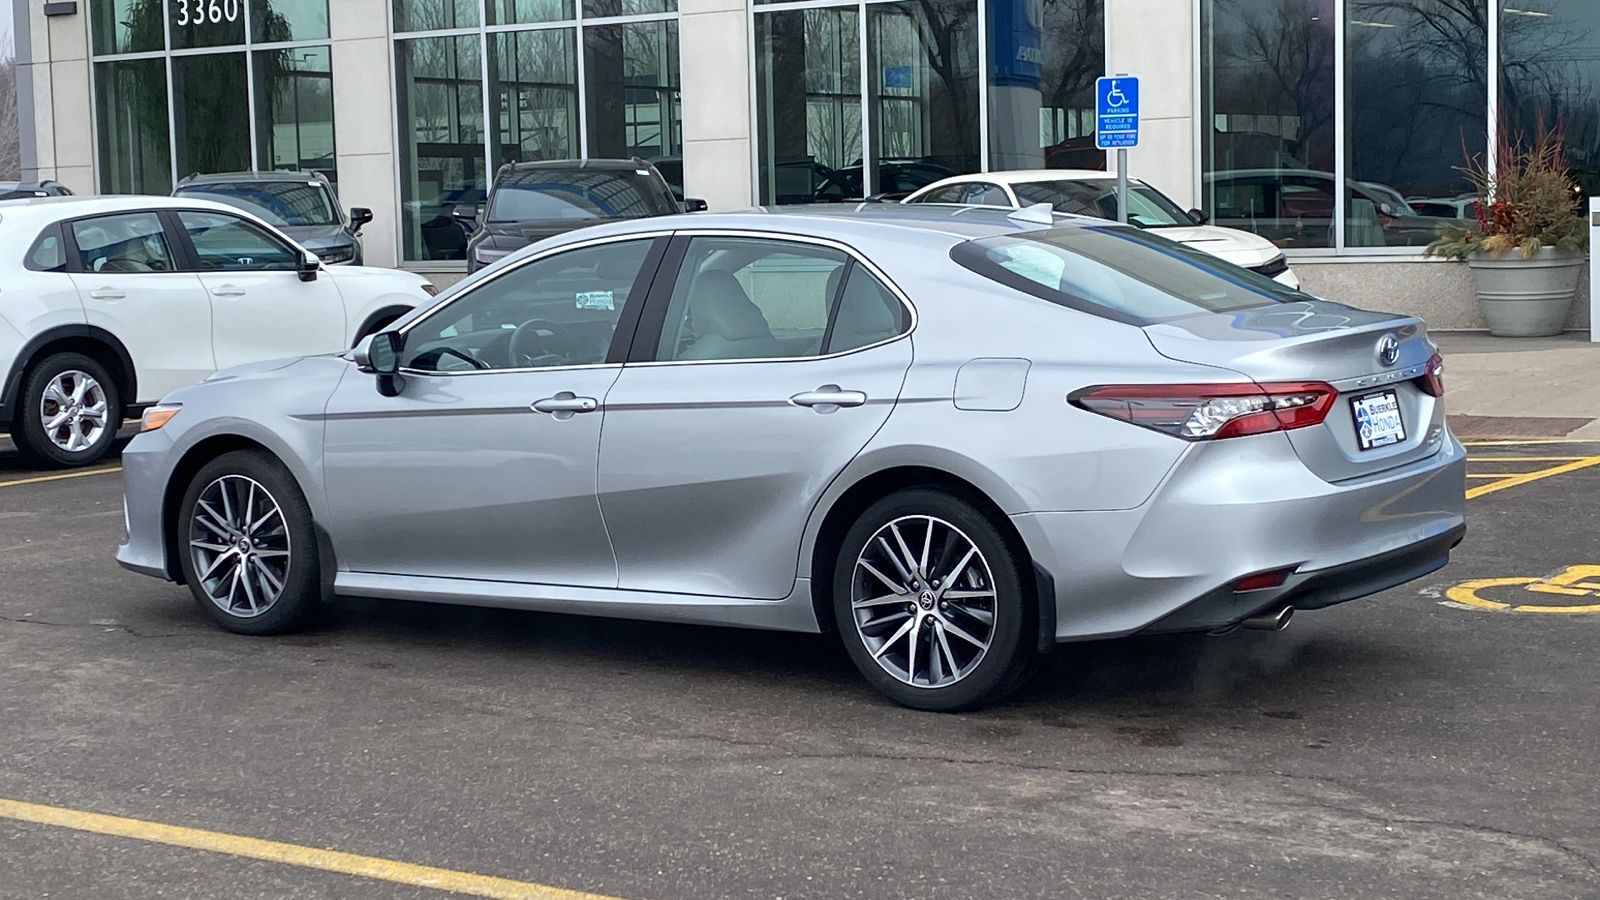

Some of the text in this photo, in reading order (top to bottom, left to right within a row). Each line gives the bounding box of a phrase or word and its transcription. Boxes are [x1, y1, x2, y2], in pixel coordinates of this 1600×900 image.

[177, 0, 238, 26] 3360
[1369, 401, 1397, 415] BUERKLE
[1371, 414, 1400, 433] HONDA
